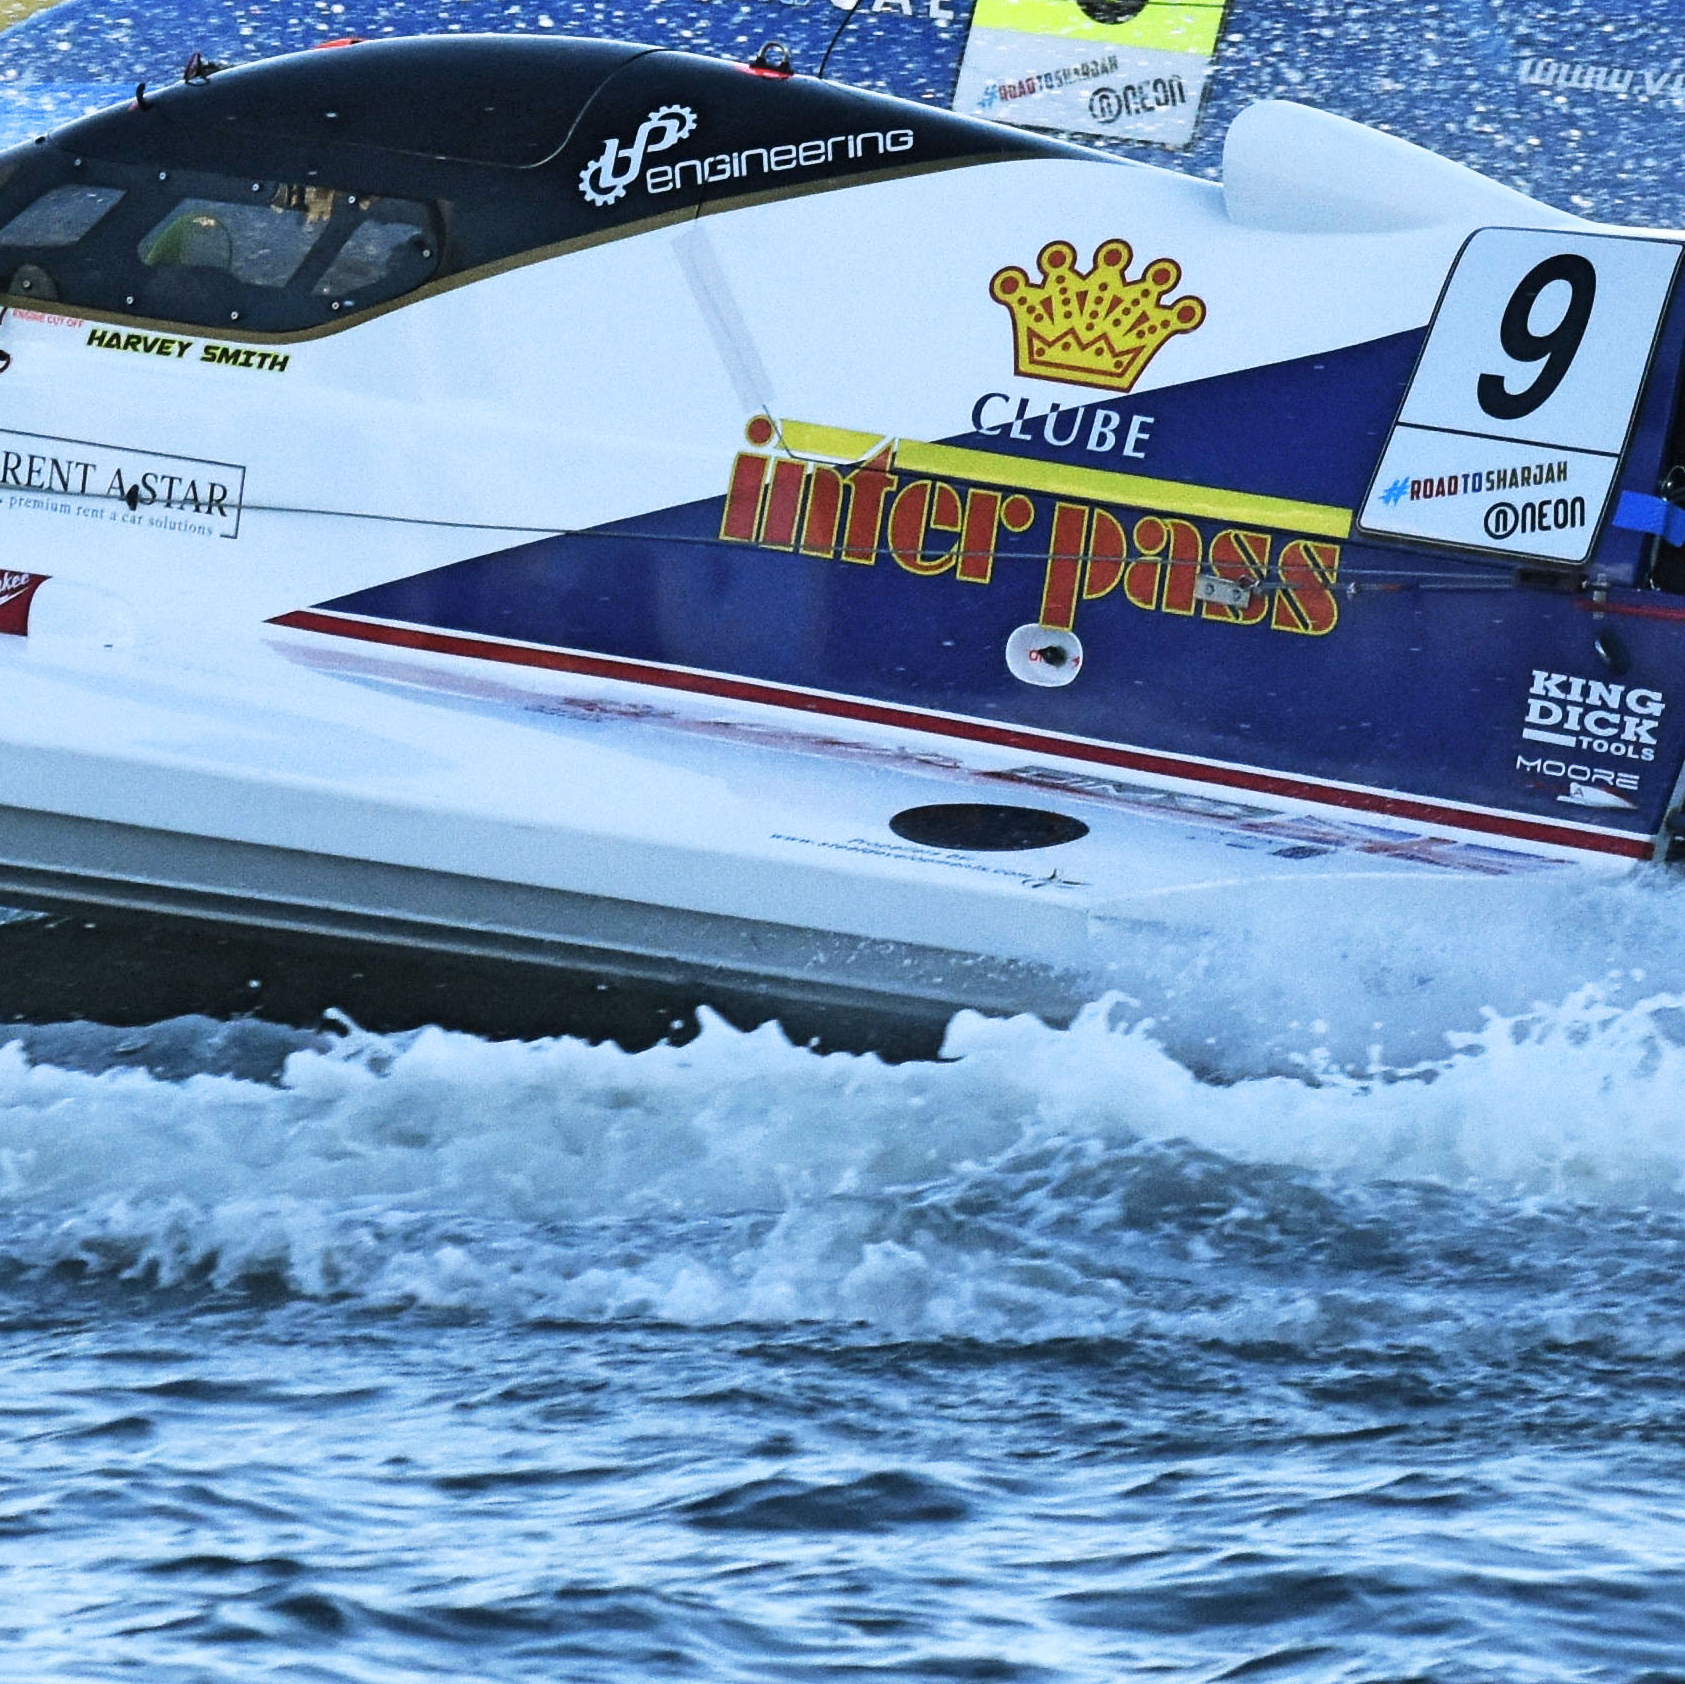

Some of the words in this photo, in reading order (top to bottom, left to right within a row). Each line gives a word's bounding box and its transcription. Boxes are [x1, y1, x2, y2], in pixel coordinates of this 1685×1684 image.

[645, 126, 915, 195] engineering
[86, 328, 194, 359] HARVEY
[200, 344, 291, 373] SMITH
[1476, 252, 1597, 420] 9
[971, 390, 1156, 460] CLUBE
[0, 450, 97, 494] RENT
[106, 467, 128, 498] A
[139, 471, 228, 517] STAR
[1379, 460, 1568, 506] #ROADTOSHARJAH
[8, 494, 71, 517] premium
[77, 503, 105, 519] rent
[122, 513, 144, 527] car
[149, 515, 214, 536] solutions
[1519, 495, 1586, 535] NEON
[1527, 669, 1666, 716] KING
[1524, 697, 1660, 746] DICK
[1578, 736, 1655, 762] TOOLS
[1516, 754, 1641, 791] MOORE
